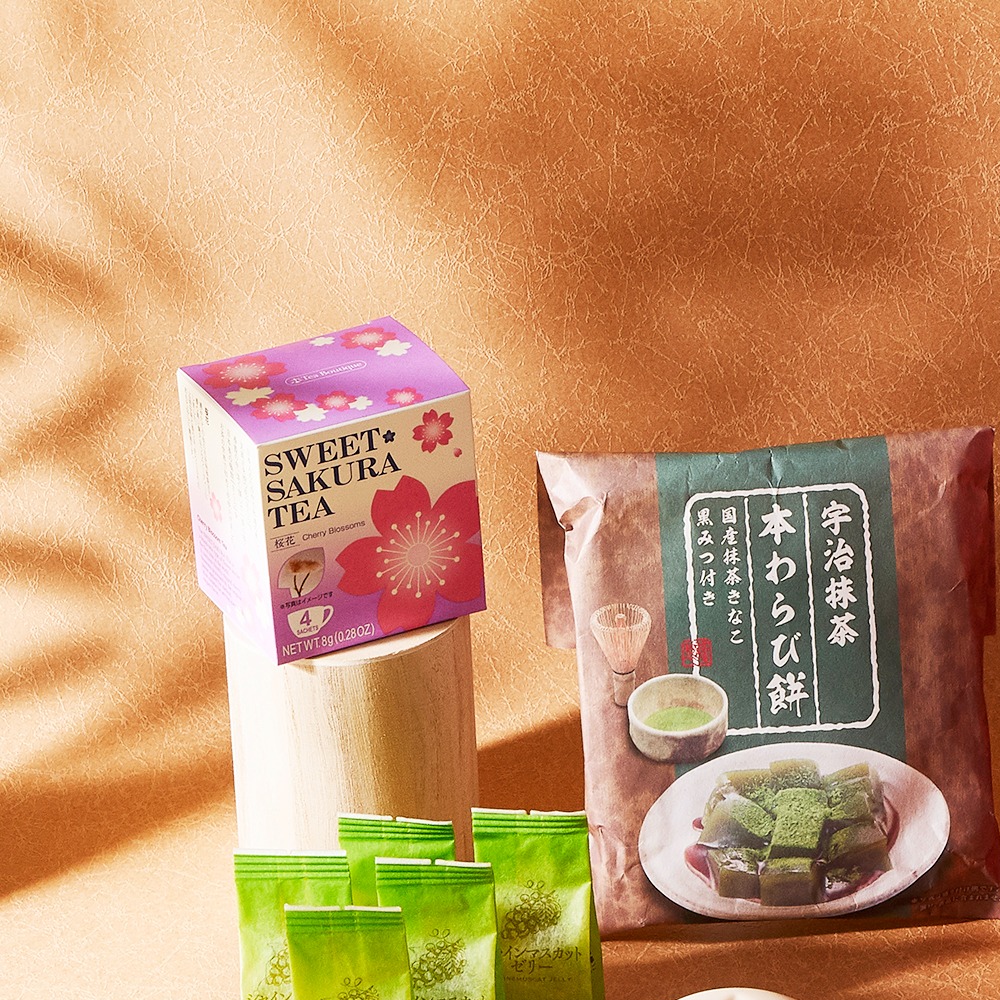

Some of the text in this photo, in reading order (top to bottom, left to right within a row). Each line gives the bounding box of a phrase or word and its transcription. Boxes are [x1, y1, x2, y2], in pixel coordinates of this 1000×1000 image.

[264, 428, 381, 476] SWEET
[266, 452, 402, 503] SAKURA
[267, 496, 336, 529] TEA
[274, 536, 296, 549] 桜花
[302, 520, 366, 541] Cherry Blossoms
[696, 508, 717, 606] 黒みつ付き
[821, 500, 859, 647] 宇治抹茶
[721, 507, 744, 644] 国産抹茶きなこ
[300, 610, 312, 627] 4
[758, 503, 811, 718] 本わらび餅
[296, 625, 319, 635] SACHETS
[501, 946, 582, 961] インマスカット
[511, 960, 553, 974] ゼリー
